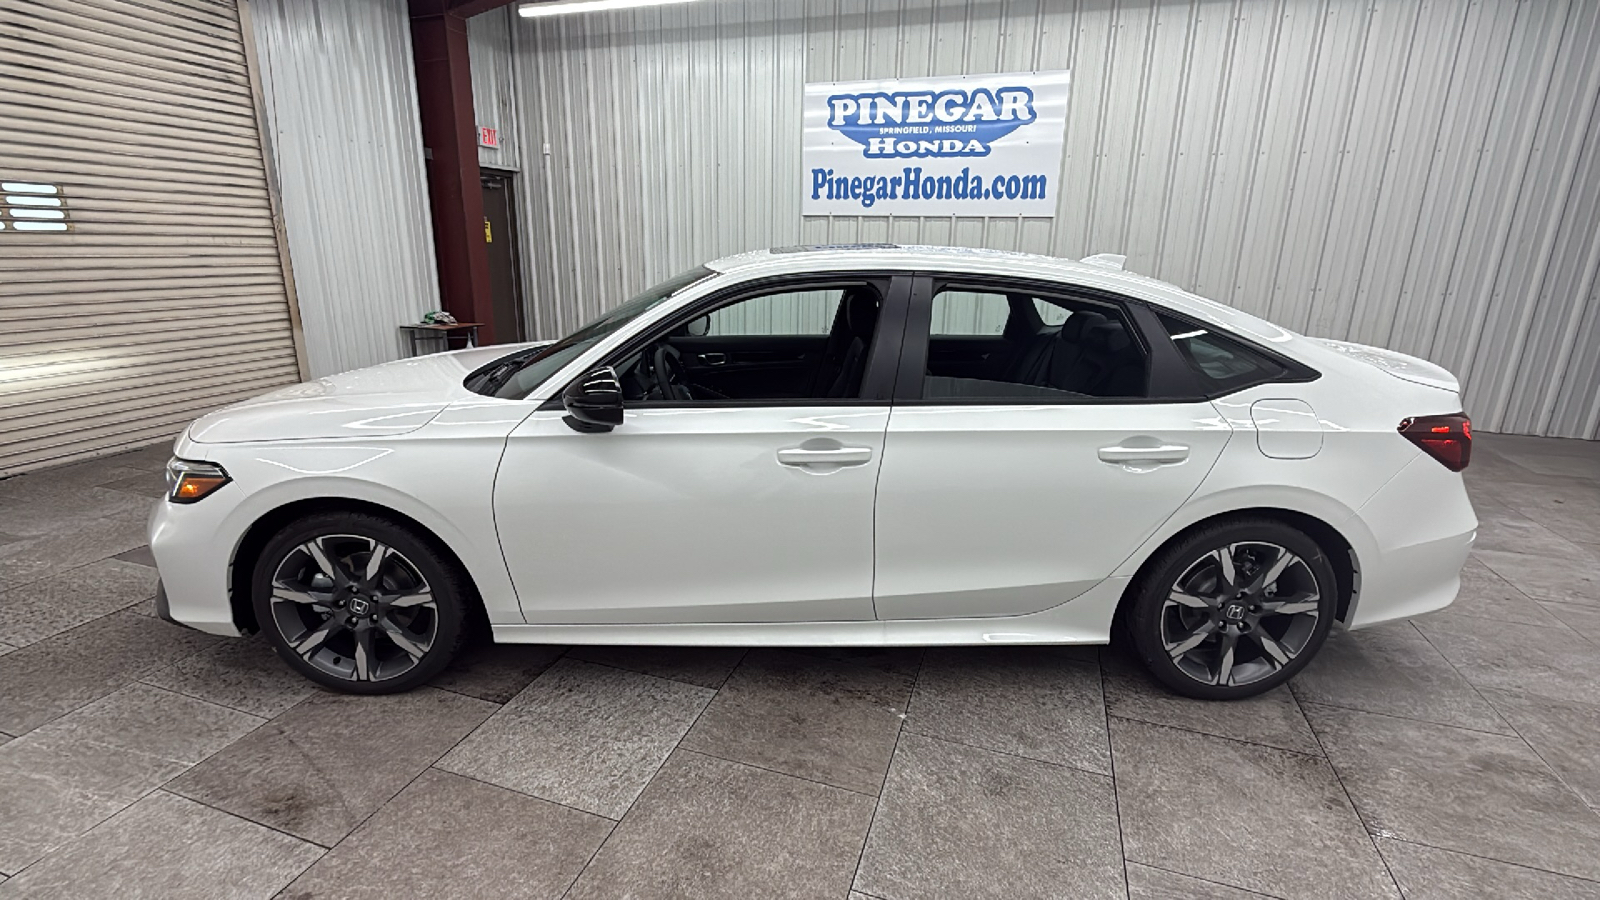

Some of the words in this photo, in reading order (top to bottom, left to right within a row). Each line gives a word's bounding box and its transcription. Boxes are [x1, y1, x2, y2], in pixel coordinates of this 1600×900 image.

[831, 91, 1033, 126] PINEGAR
[482, 128, 497, 146] EXIT
[879, 126, 932, 135] SPRINGFIELD,
[935, 124, 976, 133] MISSOURI
[811, 167, 1047, 207] PinegarHonda.com
